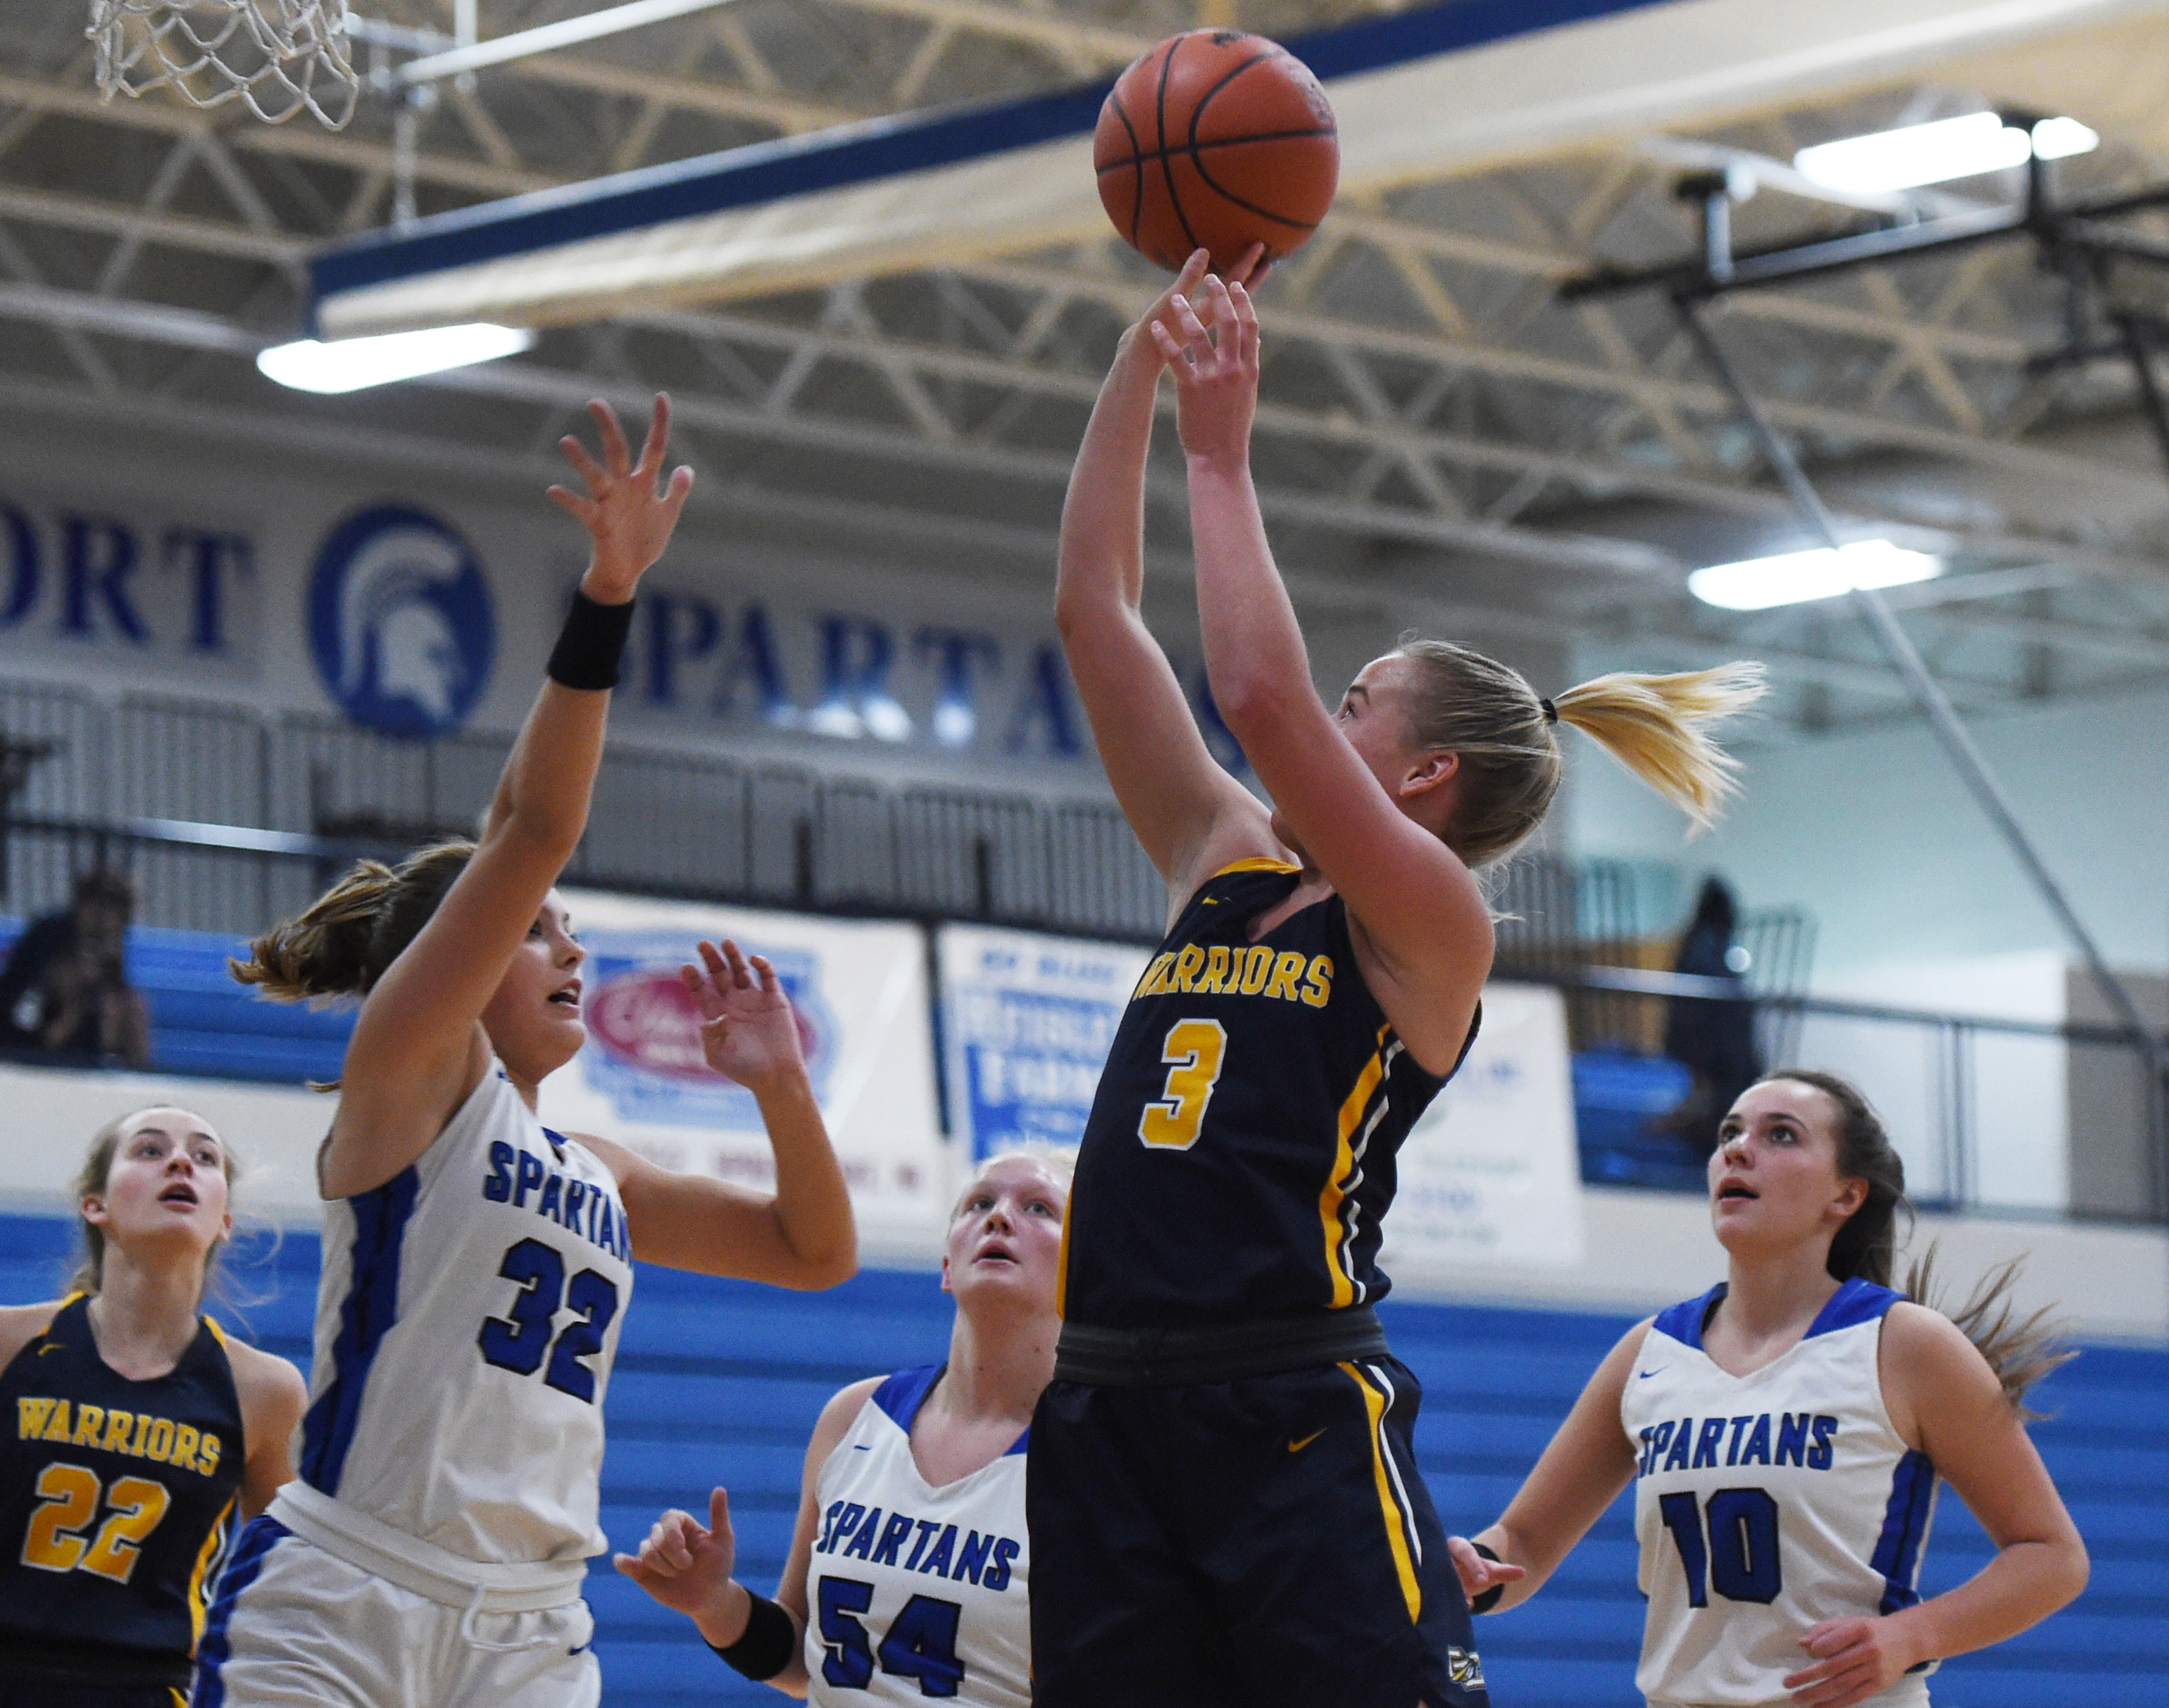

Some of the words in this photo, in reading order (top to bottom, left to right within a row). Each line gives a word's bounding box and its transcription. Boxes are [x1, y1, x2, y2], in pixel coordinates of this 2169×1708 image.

[1132, 943, 1335, 1008] WARRIORS
[1137, 1018, 1228, 1151] 3
[477, 1237, 619, 1405] 32
[17, 1396, 221, 1477] WARRIORS
[1638, 1412, 1839, 1478] SPARTANS
[20, 1462, 172, 1585] 22
[816, 1500, 1020, 1592] SPARTANS
[1658, 1487, 1782, 1608] 10
[818, 1575, 965, 1697] 54
